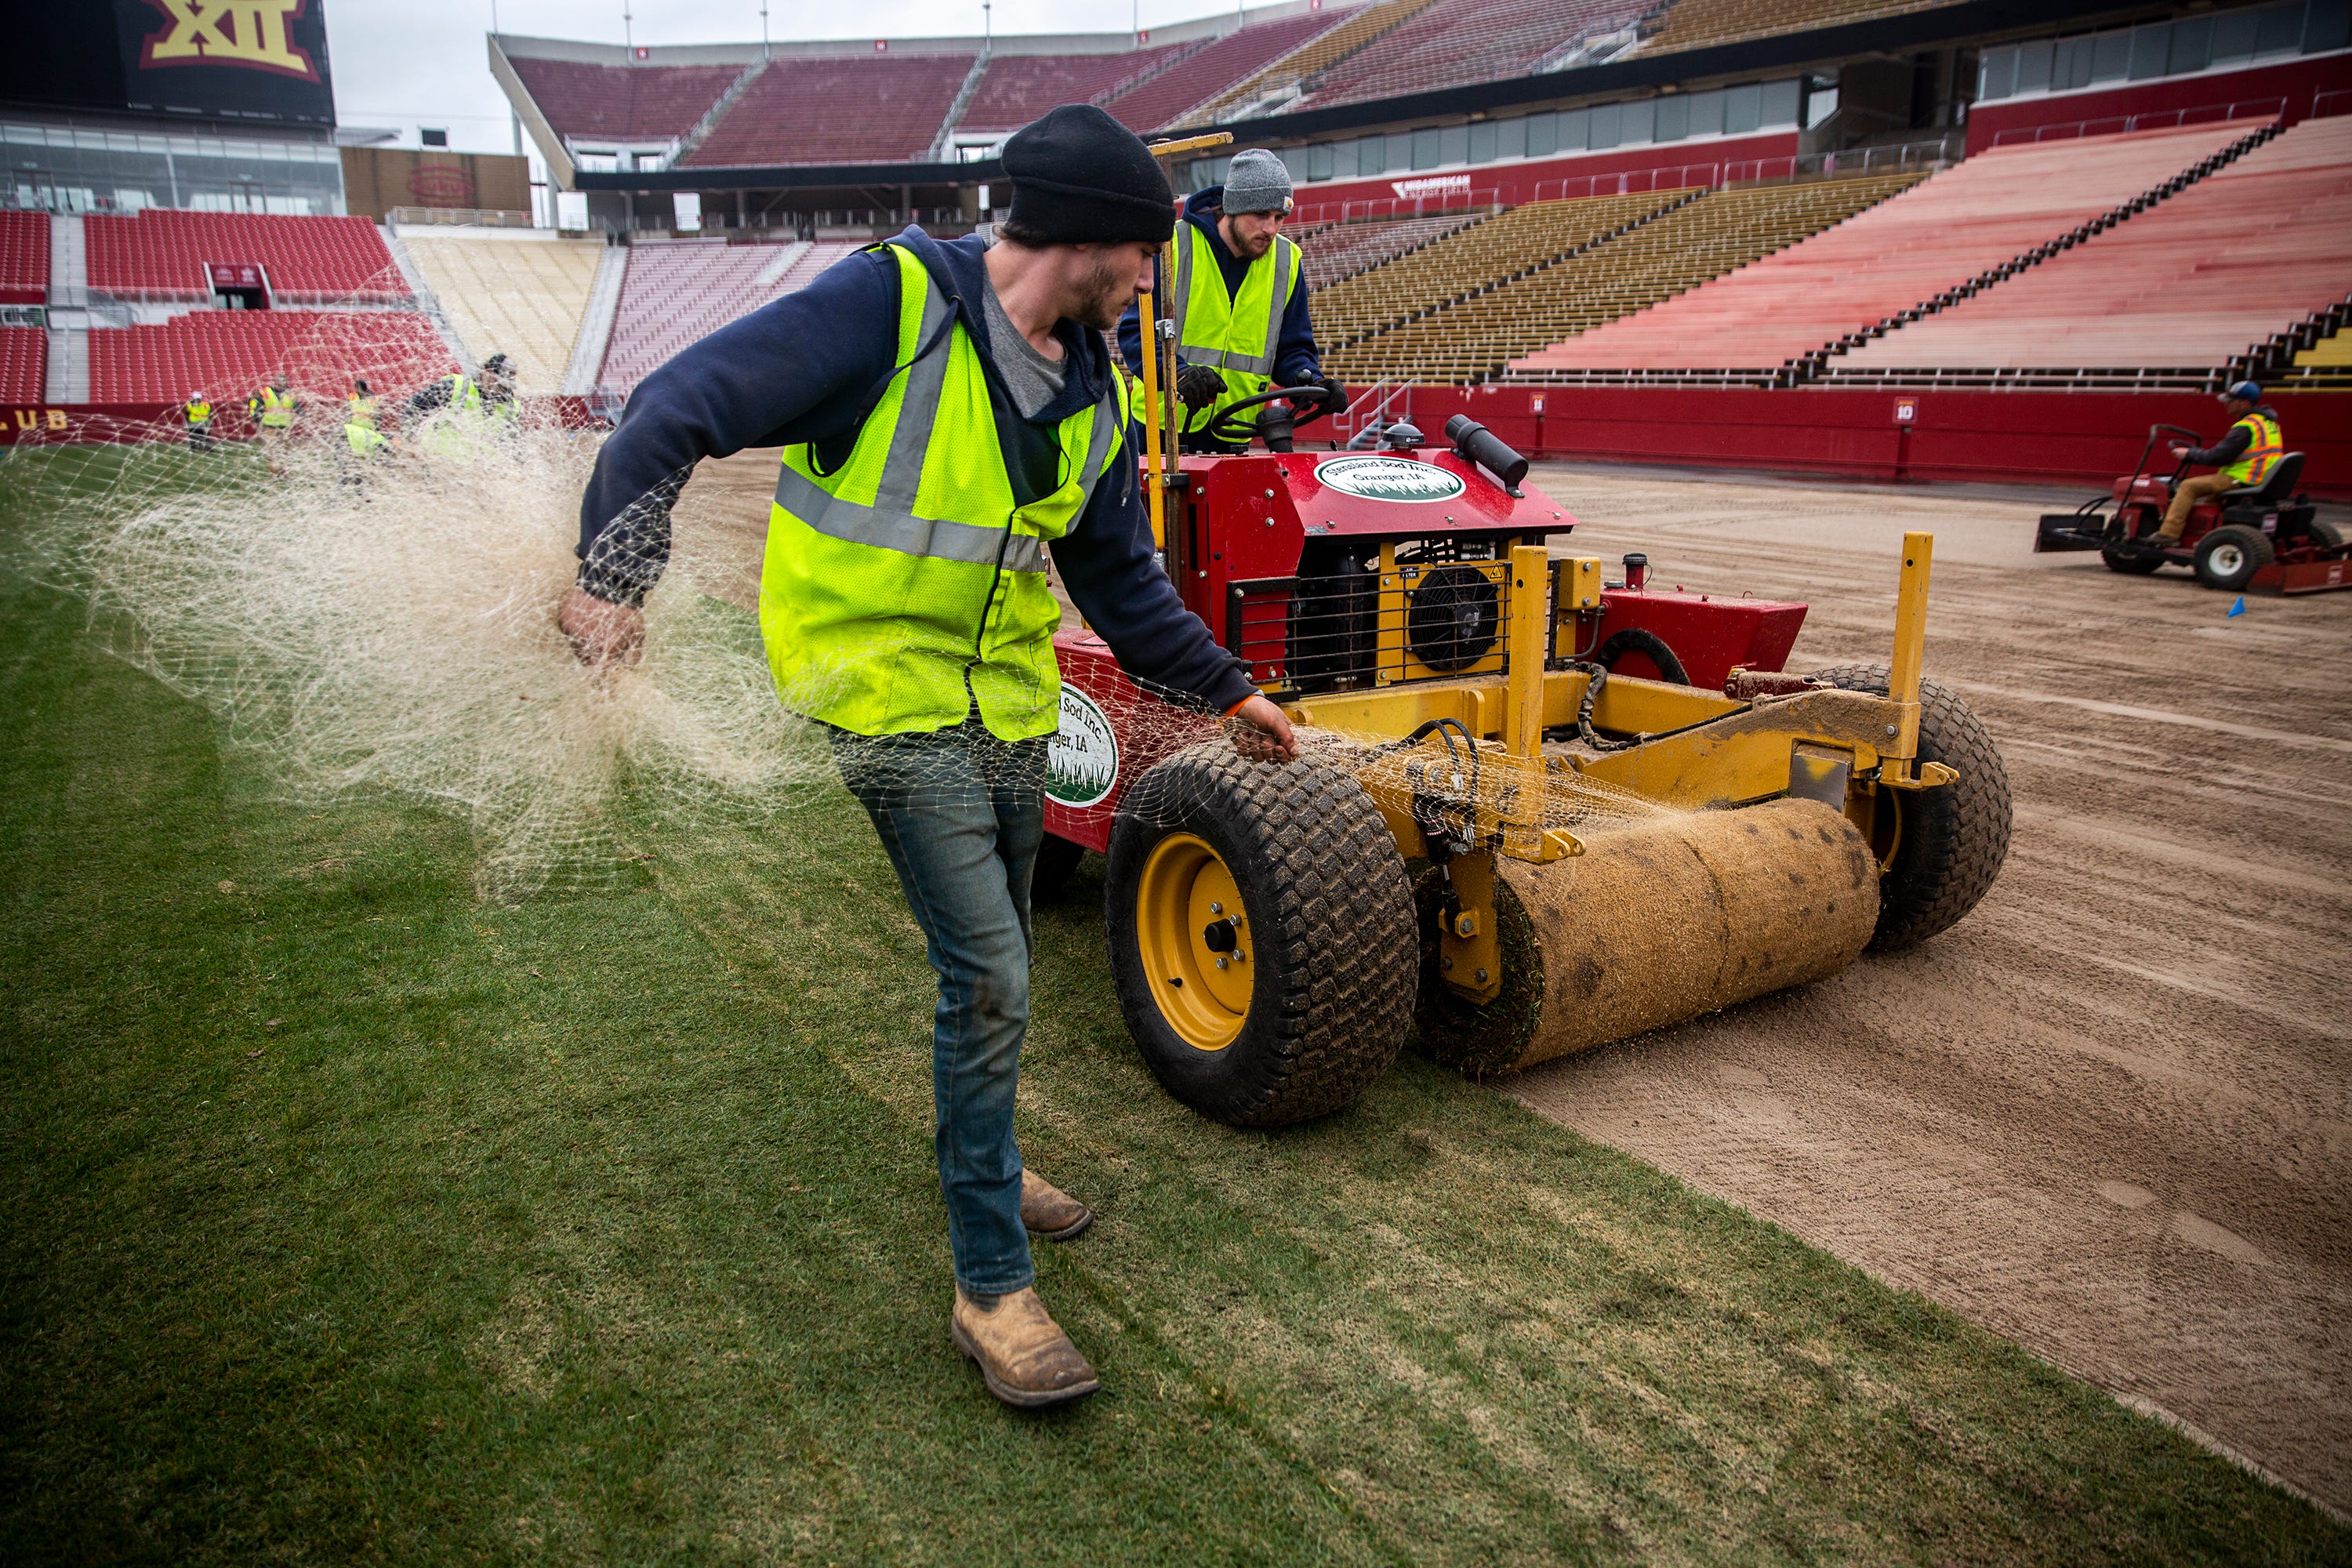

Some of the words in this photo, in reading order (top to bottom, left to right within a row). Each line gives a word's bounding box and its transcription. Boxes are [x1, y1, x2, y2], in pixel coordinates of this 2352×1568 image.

[151, 0, 309, 74] XII
[1897, 405, 1913, 419] 10
[1327, 461, 1380, 476] Stensland
[1408, 463, 1436, 475] Inc.
[1064, 697, 1083, 721] Sod
[1084, 710, 1102, 743] Inc.
[1076, 735, 1087, 753] IA
